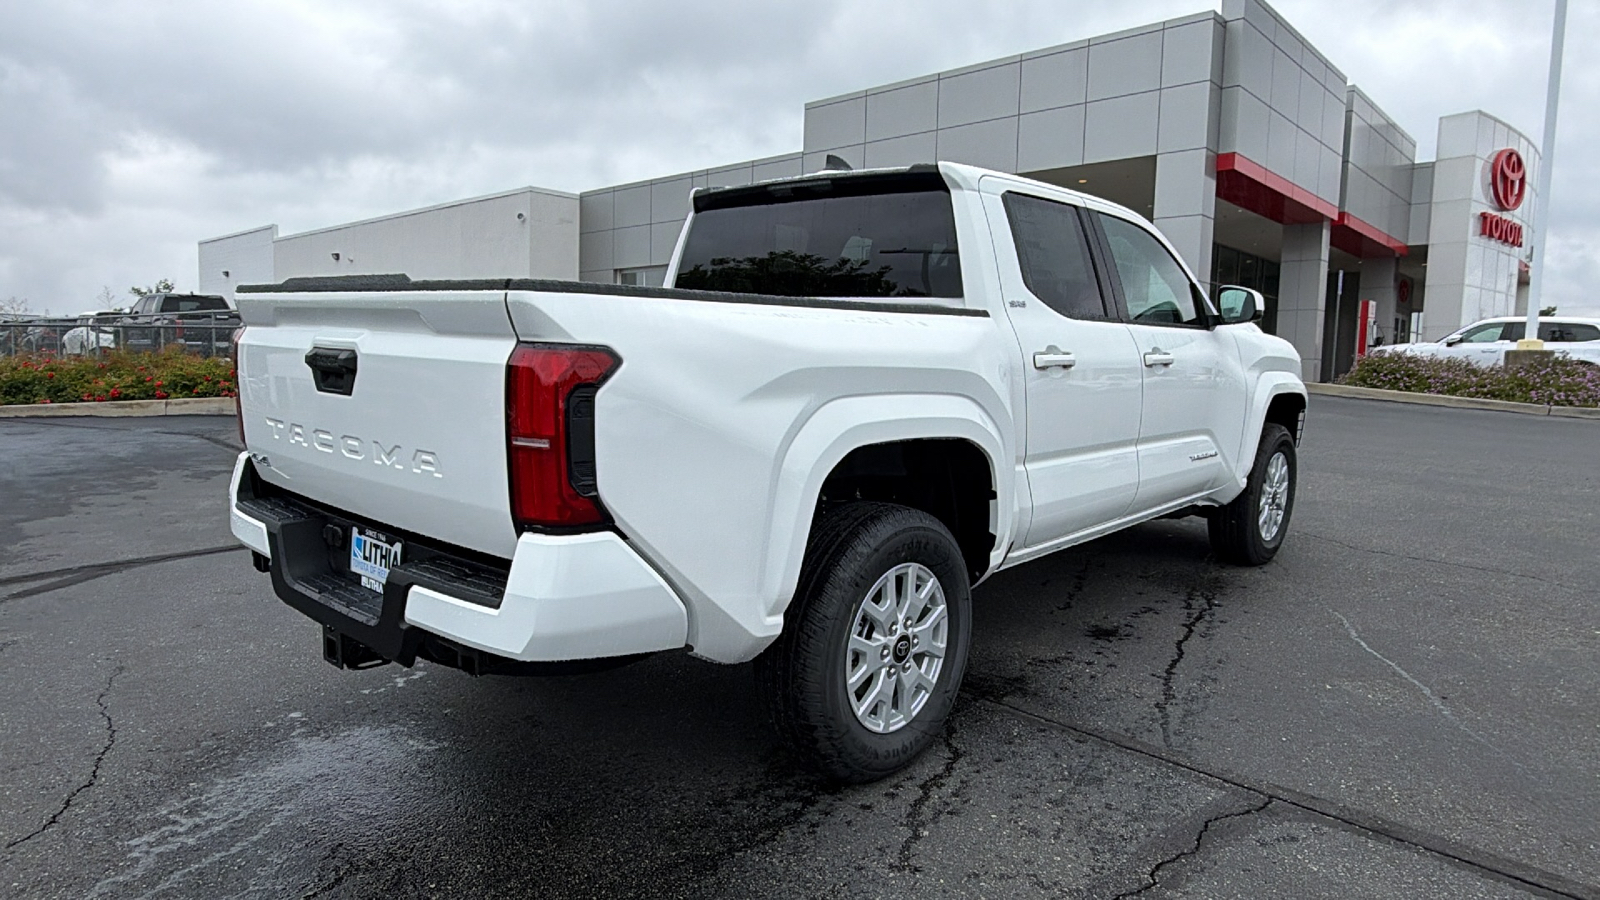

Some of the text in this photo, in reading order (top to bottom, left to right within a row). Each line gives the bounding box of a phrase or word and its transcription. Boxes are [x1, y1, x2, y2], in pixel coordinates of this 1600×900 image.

[1480, 212, 1522, 248] TOYOTA
[265, 416, 443, 478] TACOMA
[362, 540, 400, 570] LITHIA
